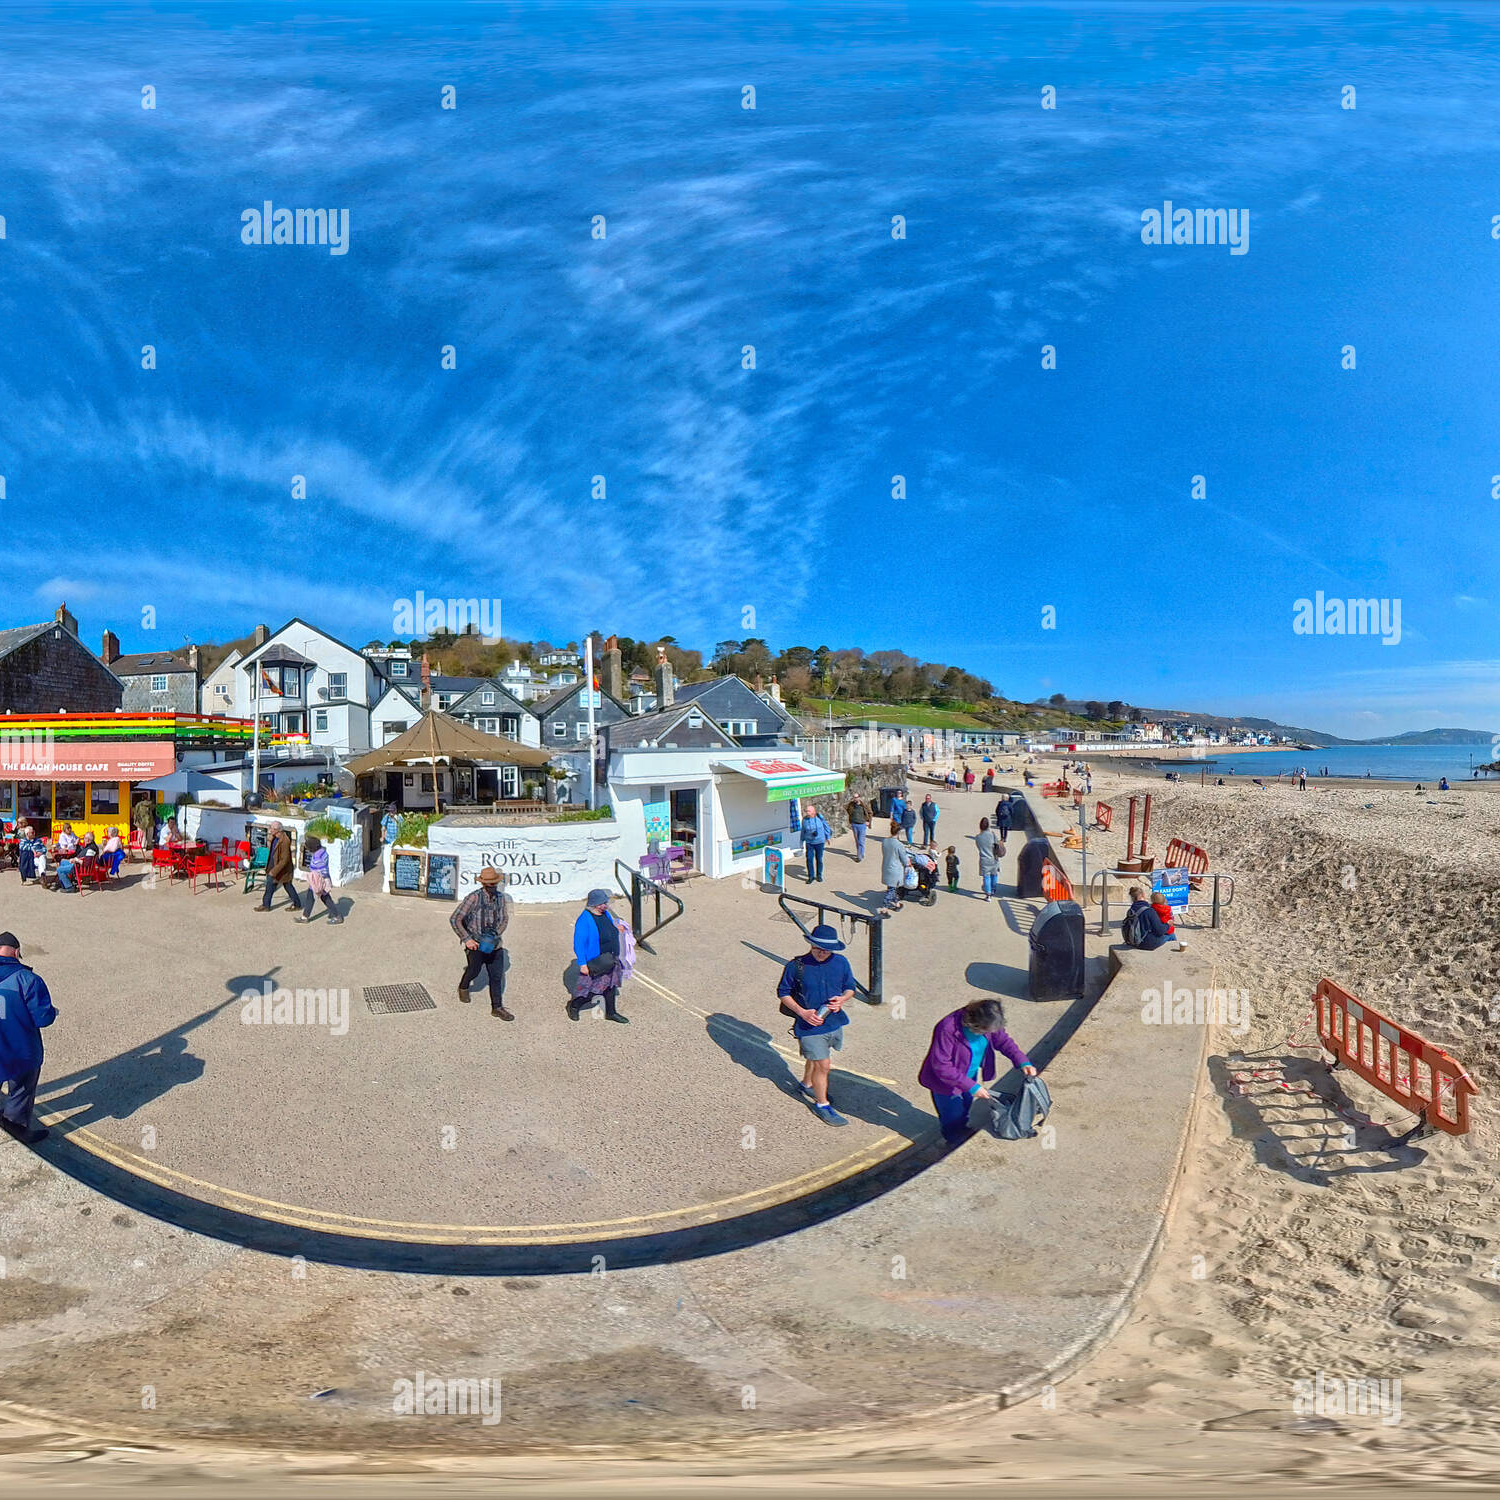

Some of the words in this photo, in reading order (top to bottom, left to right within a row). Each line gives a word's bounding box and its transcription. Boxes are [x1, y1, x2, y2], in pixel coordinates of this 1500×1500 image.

[2, 763, 18, 771] THE
[20, 763, 50, 771] BEACH
[52, 764, 83, 772] HOUSE
[85, 764, 108, 772] CAFE
[496, 841, 518, 849] THE
[482, 853, 540, 867] ROYAL
[460, 871, 562, 886] STDARD
